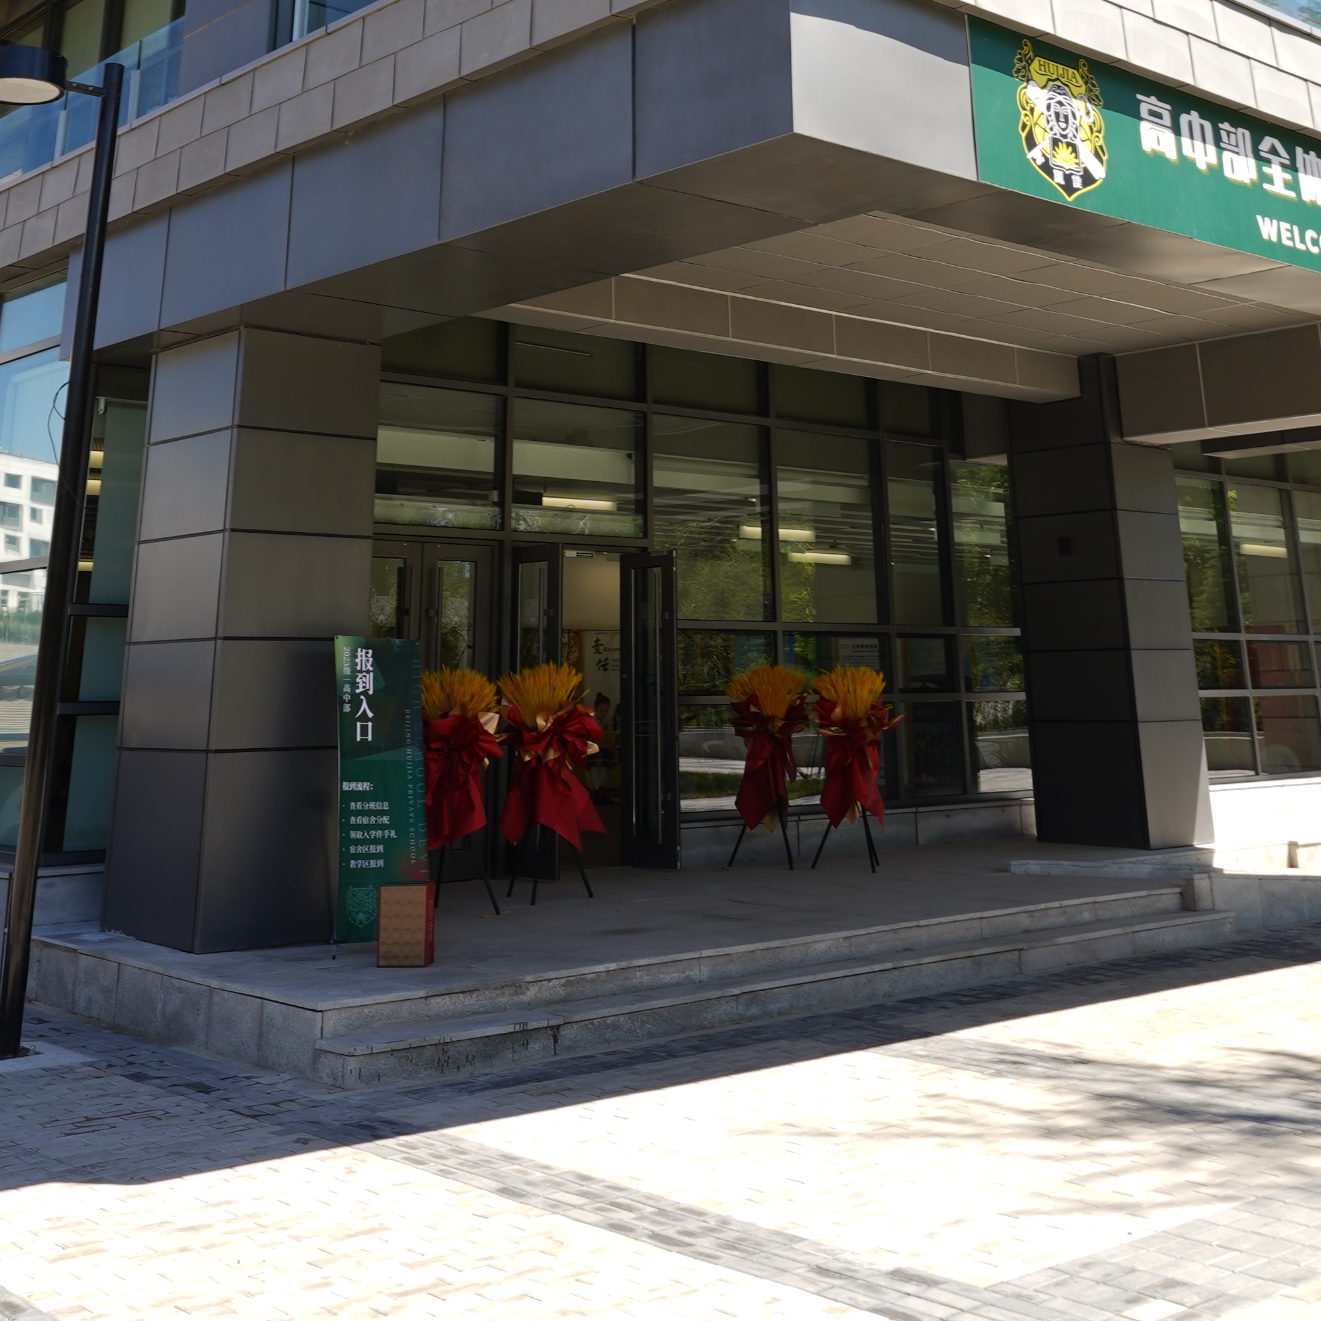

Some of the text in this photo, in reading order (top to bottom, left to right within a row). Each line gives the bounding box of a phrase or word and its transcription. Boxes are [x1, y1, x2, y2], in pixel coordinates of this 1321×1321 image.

[1038, 58, 1079, 84] HUIJIA
[354, 647, 375, 743] 报到入口
[404, 709, 412, 745] BEIJING
[407, 784, 415, 824] PRIVATE
[349, 845, 384, 854] 宿舍区报到
[349, 860, 384, 868] 教学区报到
[409, 827, 418, 866] SCHOOL
